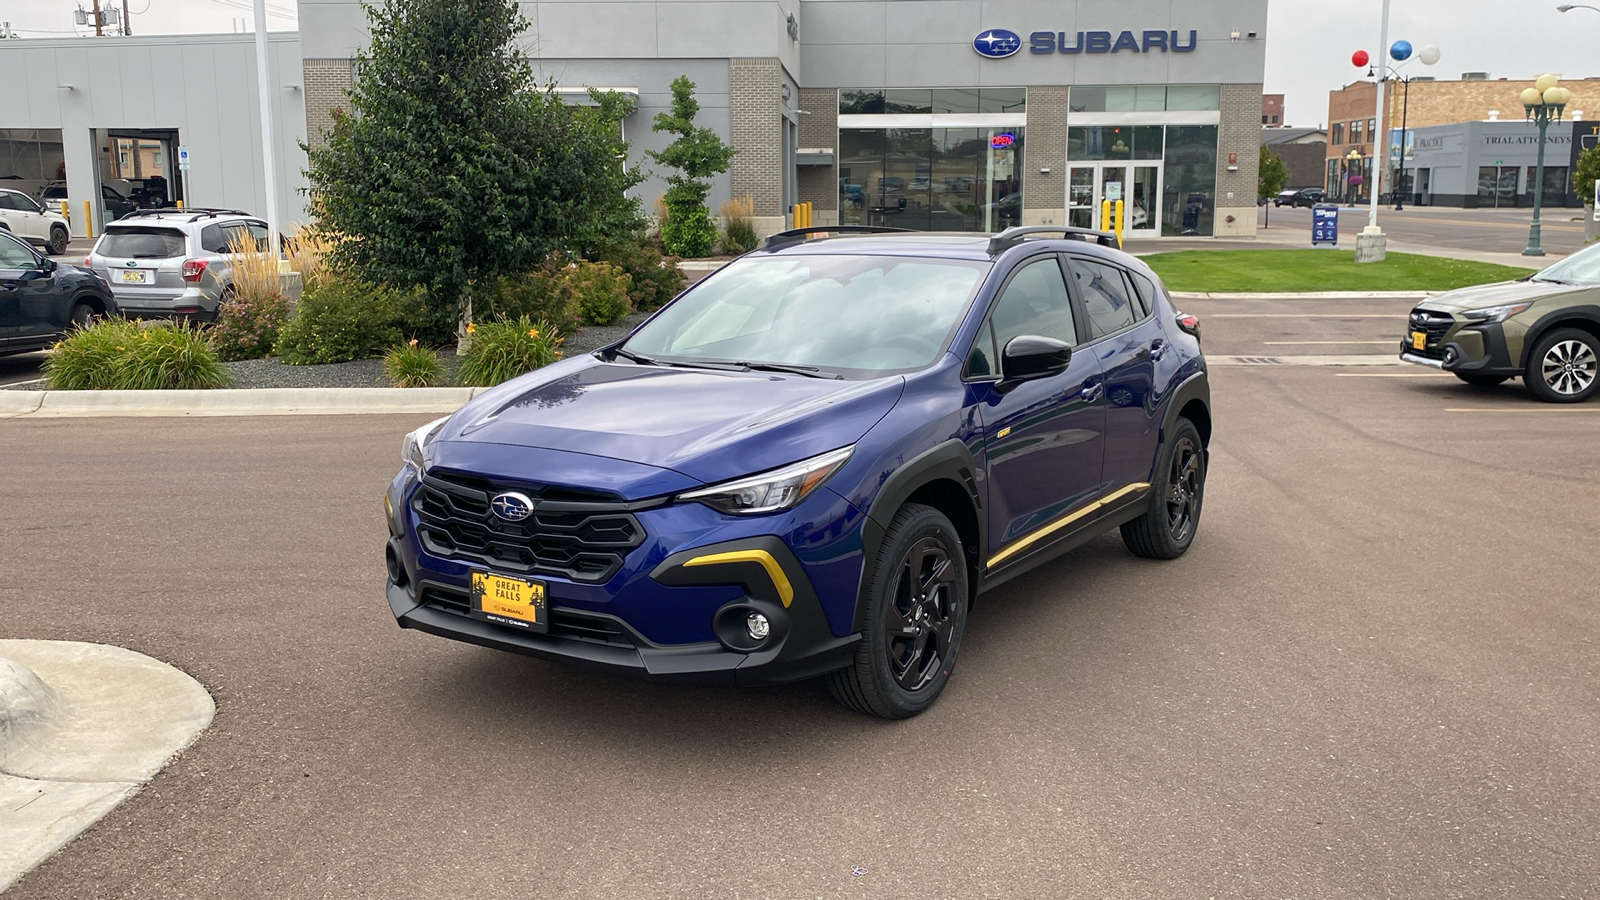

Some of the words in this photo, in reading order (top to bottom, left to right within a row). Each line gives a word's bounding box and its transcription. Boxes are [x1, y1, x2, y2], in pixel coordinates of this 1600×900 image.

[1029, 30, 1197, 54] SUBARU
[991, 136, 1012, 145] OPEN
[1485, 136, 1513, 144] TRIAL
[495, 580, 521, 592] GREAT
[495, 589, 521, 602] FALLS
[501, 606, 524, 615] SUBARU
